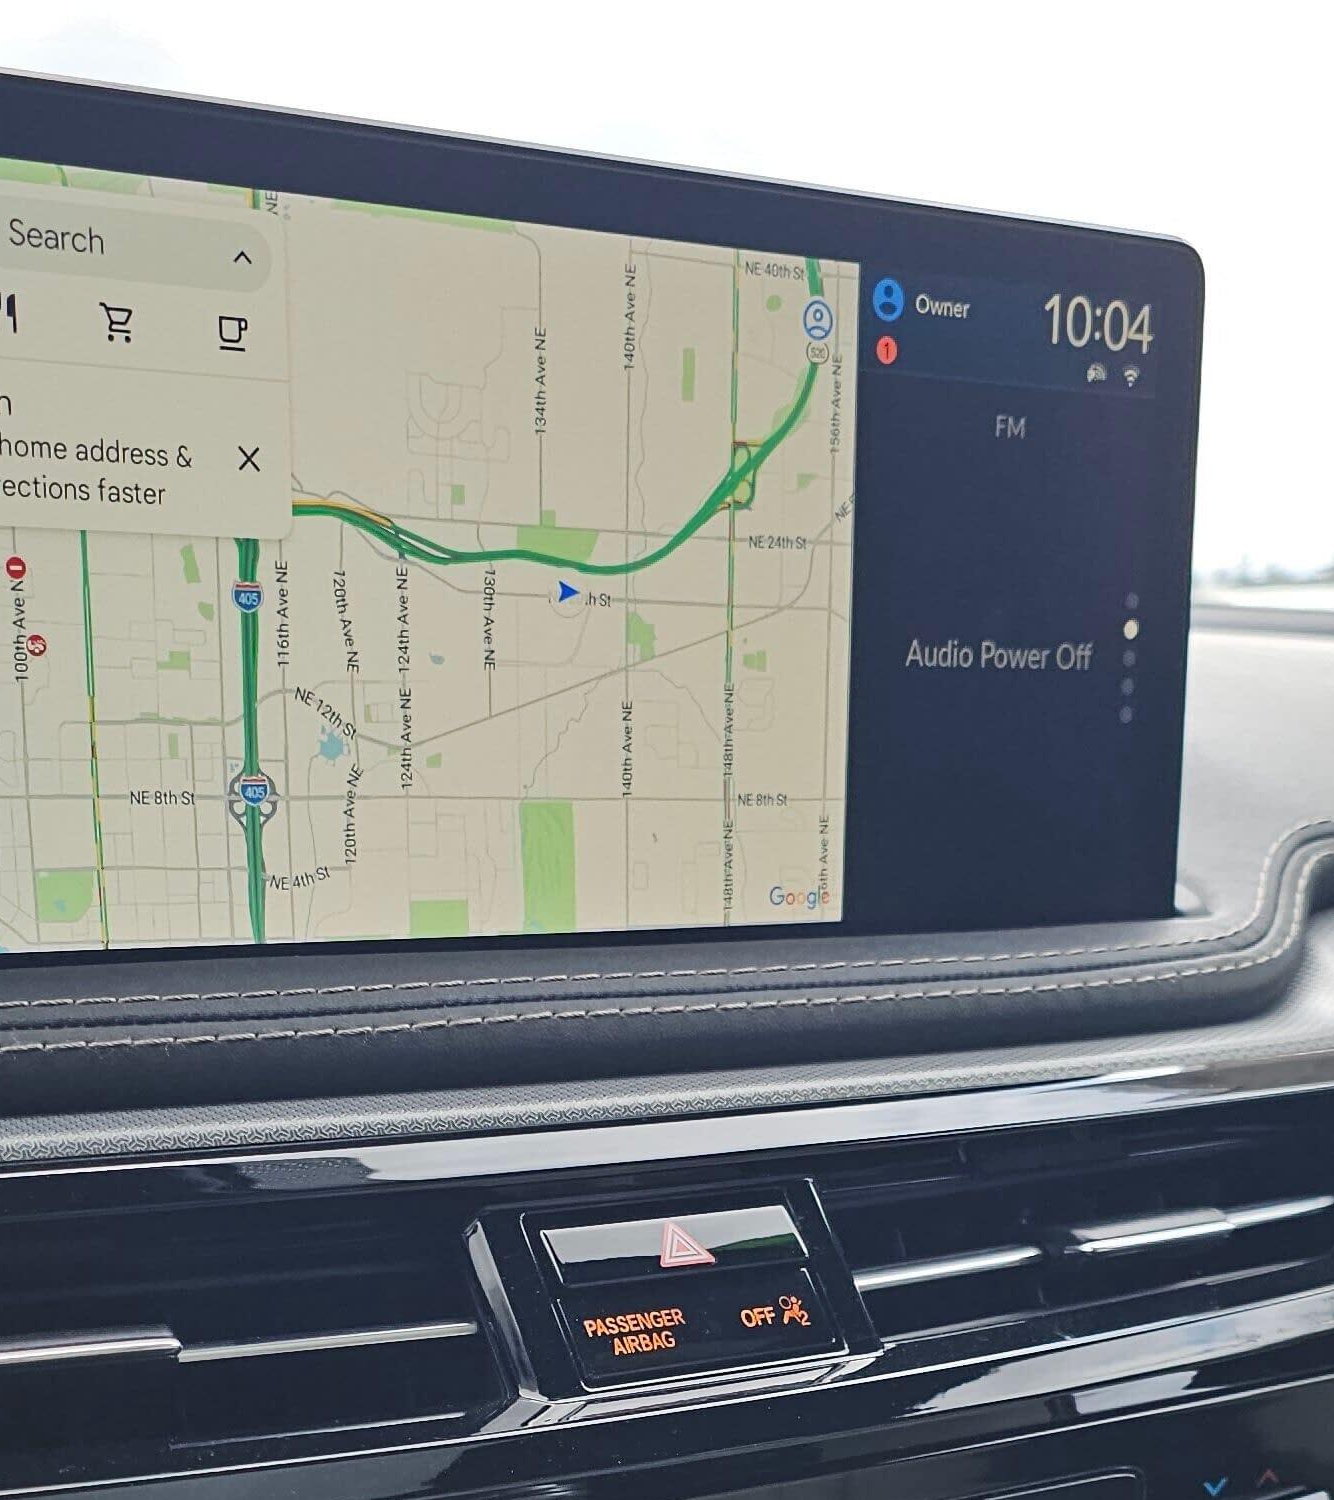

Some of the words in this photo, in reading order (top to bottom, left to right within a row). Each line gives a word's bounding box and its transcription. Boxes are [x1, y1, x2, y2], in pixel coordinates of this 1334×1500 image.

[9, 218, 105, 256] Search
[625, 263, 636, 287] NE
[745, 261, 762, 276] NE
[765, 263, 790, 278] 40th
[793, 266, 804, 281] St
[625, 292, 636, 322] Ave
[915, 294, 970, 320] Owner
[1045, 293, 1154, 354] 10:04
[534, 327, 547, 350] NE
[624, 328, 635, 370] 140th
[534, 356, 547, 386] Ave
[831, 354, 843, 376] NE
[831, 379, 842, 409] Ave
[534, 391, 547, 435] 134th
[995, 414, 1027, 440] FM
[0, 432, 67, 461] home
[75, 437, 169, 467] address
[175, 444, 193, 468] &
[98, 478, 167, 506] faster
[748, 535, 765, 549] NE
[768, 535, 793, 550] 24th
[795, 536, 807, 550] St
[275, 560, 288, 583] NE
[396, 566, 408, 590] NE
[10, 580, 24, 592] N
[238, 592, 259, 606] 405
[333, 570, 347, 614] 120th
[483, 569, 496, 611] 130th
[599, 593, 611, 607] St
[12, 597, 27, 629] Ave
[276, 588, 289, 618] Ave
[397, 595, 409, 626] Ave
[340, 618, 355, 647] Ave
[483, 616, 495, 645] Ave
[13, 635, 29, 682] 100th
[277, 623, 289, 667] 116th
[397, 629, 410, 673] 124th
[905, 639, 973, 669] Audio
[980, 640, 1050, 670] Power
[1056, 641, 1094, 671] Off
[347, 651, 359, 673] NE
[484, 649, 496, 671] NE
[399, 687, 412, 710] NE
[724, 683, 735, 702] NE
[295, 687, 316, 707] NE
[316, 699, 342, 728] 12th
[342, 722, 357, 740] St
[622, 701, 633, 722] NE
[723, 703, 734, 734] Ave
[400, 714, 412, 743] Ave
[622, 726, 632, 753] Ave
[400, 747, 413, 790] 124th
[723, 739, 734, 777] 148th
[347, 763, 364, 789] NE
[622, 758, 632, 798] 140th
[130, 791, 150, 805] NE
[154, 791, 178, 805] 8th
[181, 791, 196, 806] St
[244, 786, 265, 799] 405
[343, 790, 356, 820] Ave
[737, 794, 752, 807] NE
[756, 794, 774, 807] 8th
[776, 794, 787, 807] St
[723, 820, 734, 840] NE
[819, 815, 829, 834] NE
[343, 823, 356, 865] 120th
[724, 841, 734, 870] Ave
[819, 839, 829, 864] Ave
[269, 875, 289, 890] NE
[293, 872, 315, 888] 4th
[316, 866, 331, 880] St
[723, 874, 734, 912] 148th
[769, 886, 830, 910] Google
[583, 1308, 686, 1338] PASSENGER
[740, 1306, 776, 1328] OFF
[612, 1330, 676, 1356] AIRBAG
